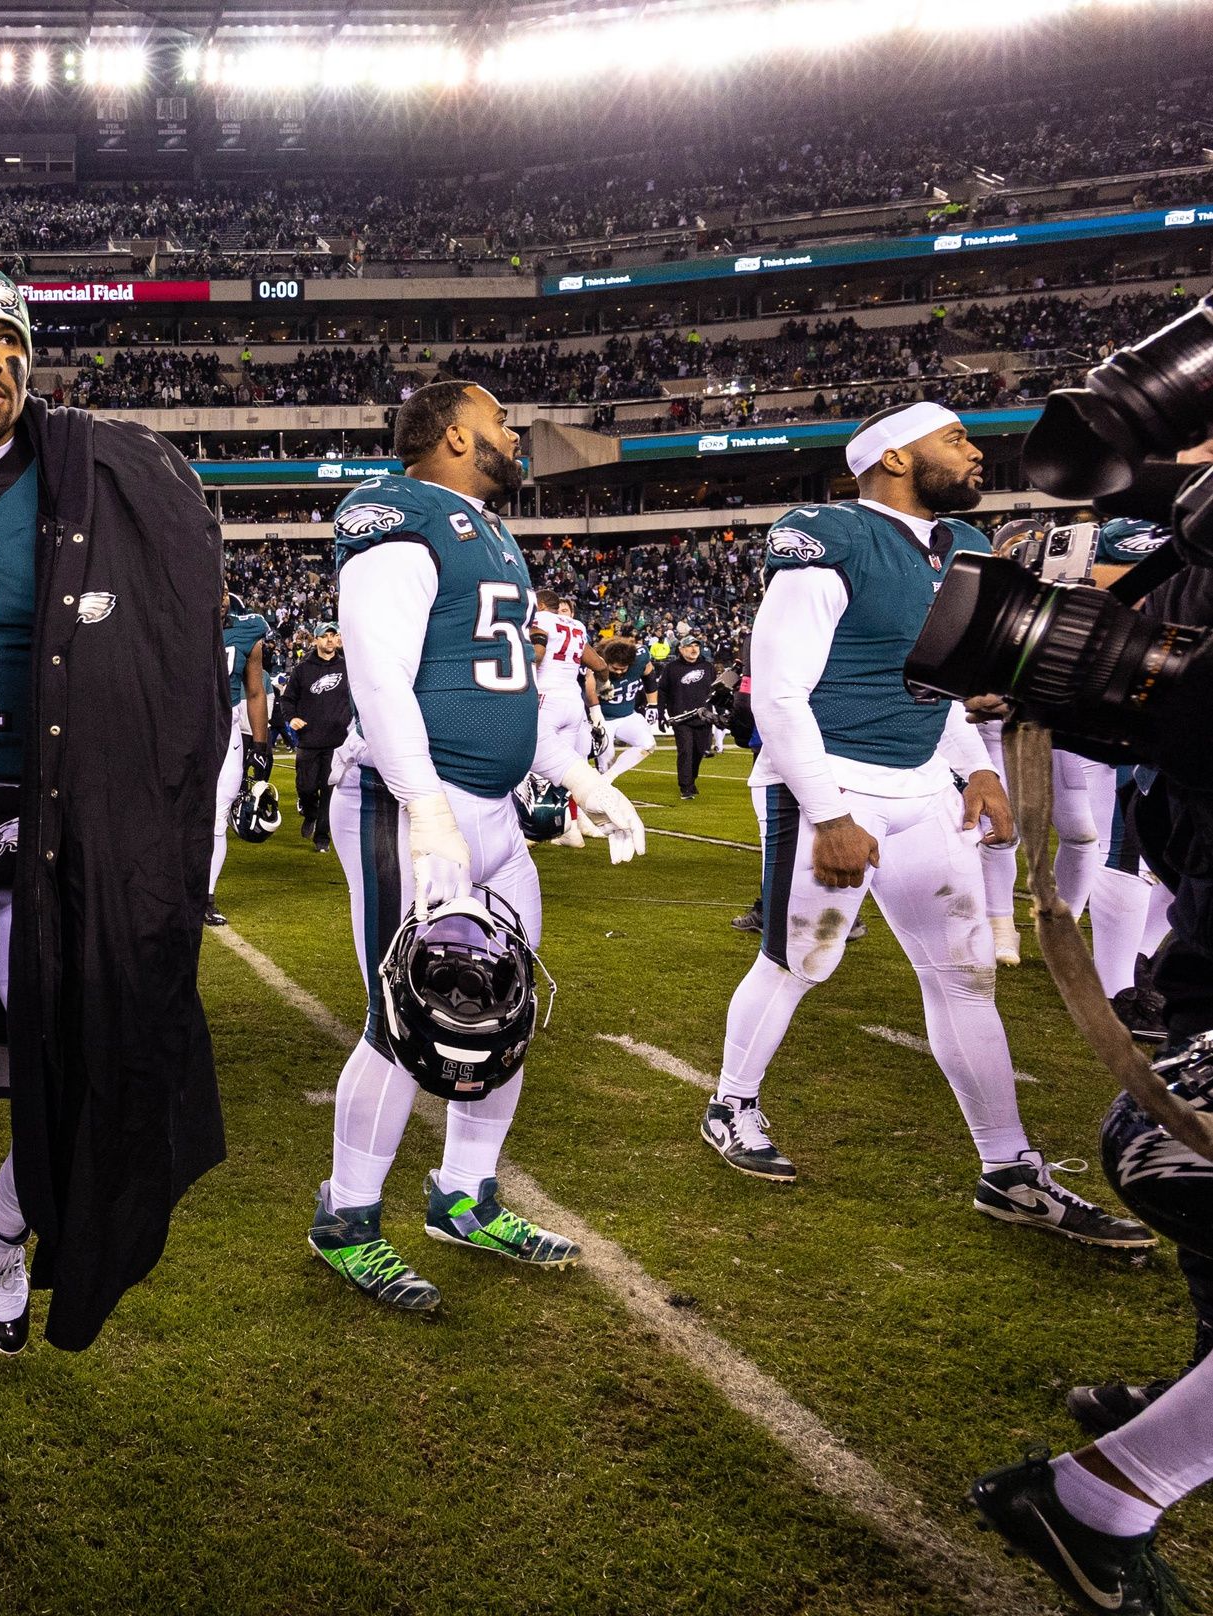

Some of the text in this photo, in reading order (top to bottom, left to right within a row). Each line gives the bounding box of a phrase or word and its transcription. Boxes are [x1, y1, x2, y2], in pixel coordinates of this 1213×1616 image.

[964, 236, 988, 246] Think
[762, 258, 784, 268] Think
[584, 278, 605, 286] Think
[18, 284, 134, 301] Financial Field
[259, 281, 298, 298] 0:00
[730, 438, 756, 447] Think
[757, 435, 788, 446] ahead.
[343, 468, 364, 476] Think
[365, 467, 390, 476] ahead.
[450, 513, 473, 534] C
[553, 623, 585, 664] 73
